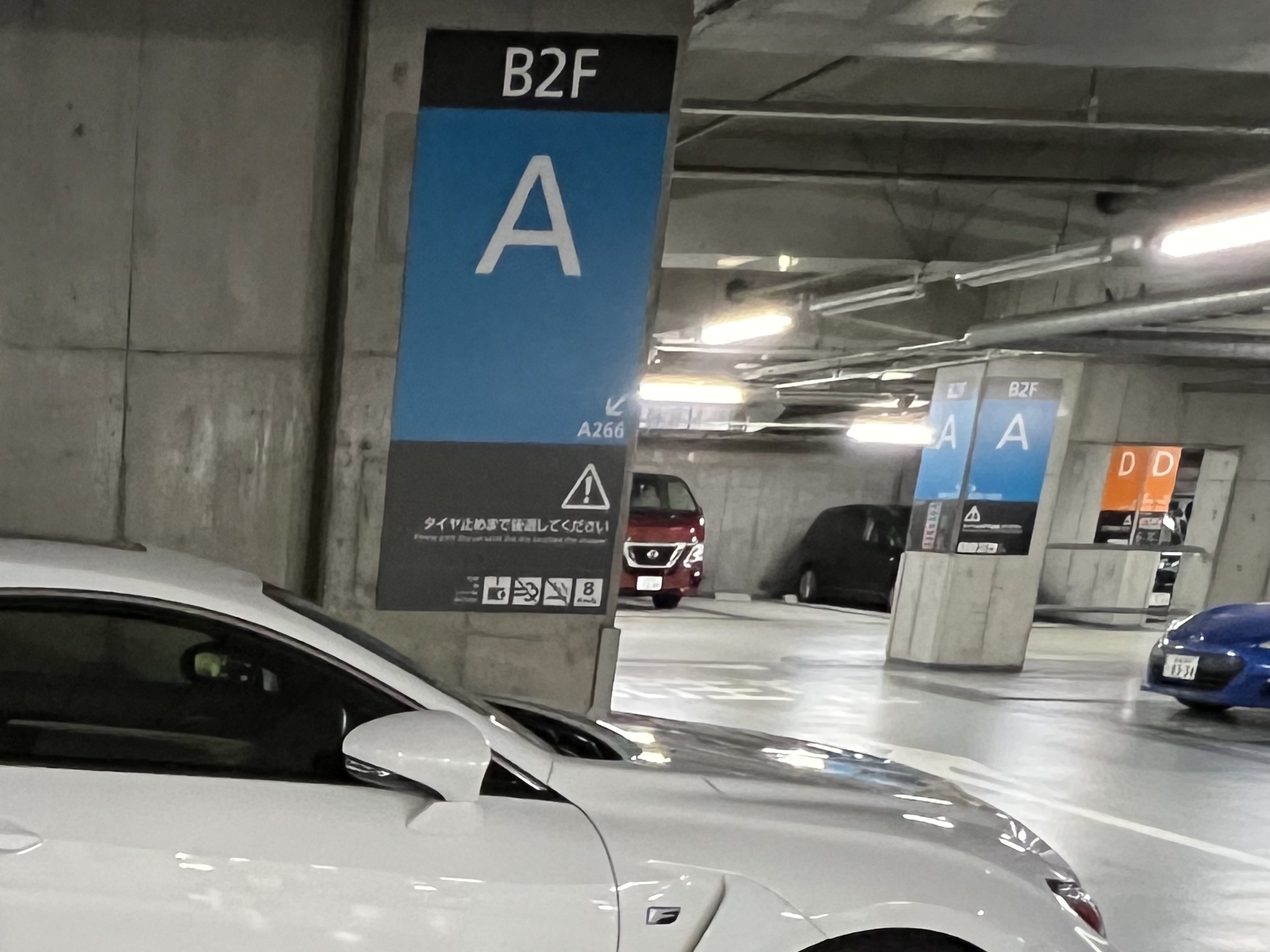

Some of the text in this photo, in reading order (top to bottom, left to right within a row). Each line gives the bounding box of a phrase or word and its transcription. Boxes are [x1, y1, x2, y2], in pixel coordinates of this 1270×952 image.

[502, 47, 600, 99] B2F
[475, 154, 581, 277] A
[1009, 381, 1039, 397] B2F
[577, 421, 624, 438] A266
[935, 413, 956, 450] A
[995, 412, 1029, 450] A
[1118, 451, 1135, 476] D
[1152, 450, 1174, 476] D
[583, 582, 594, 595] 8
